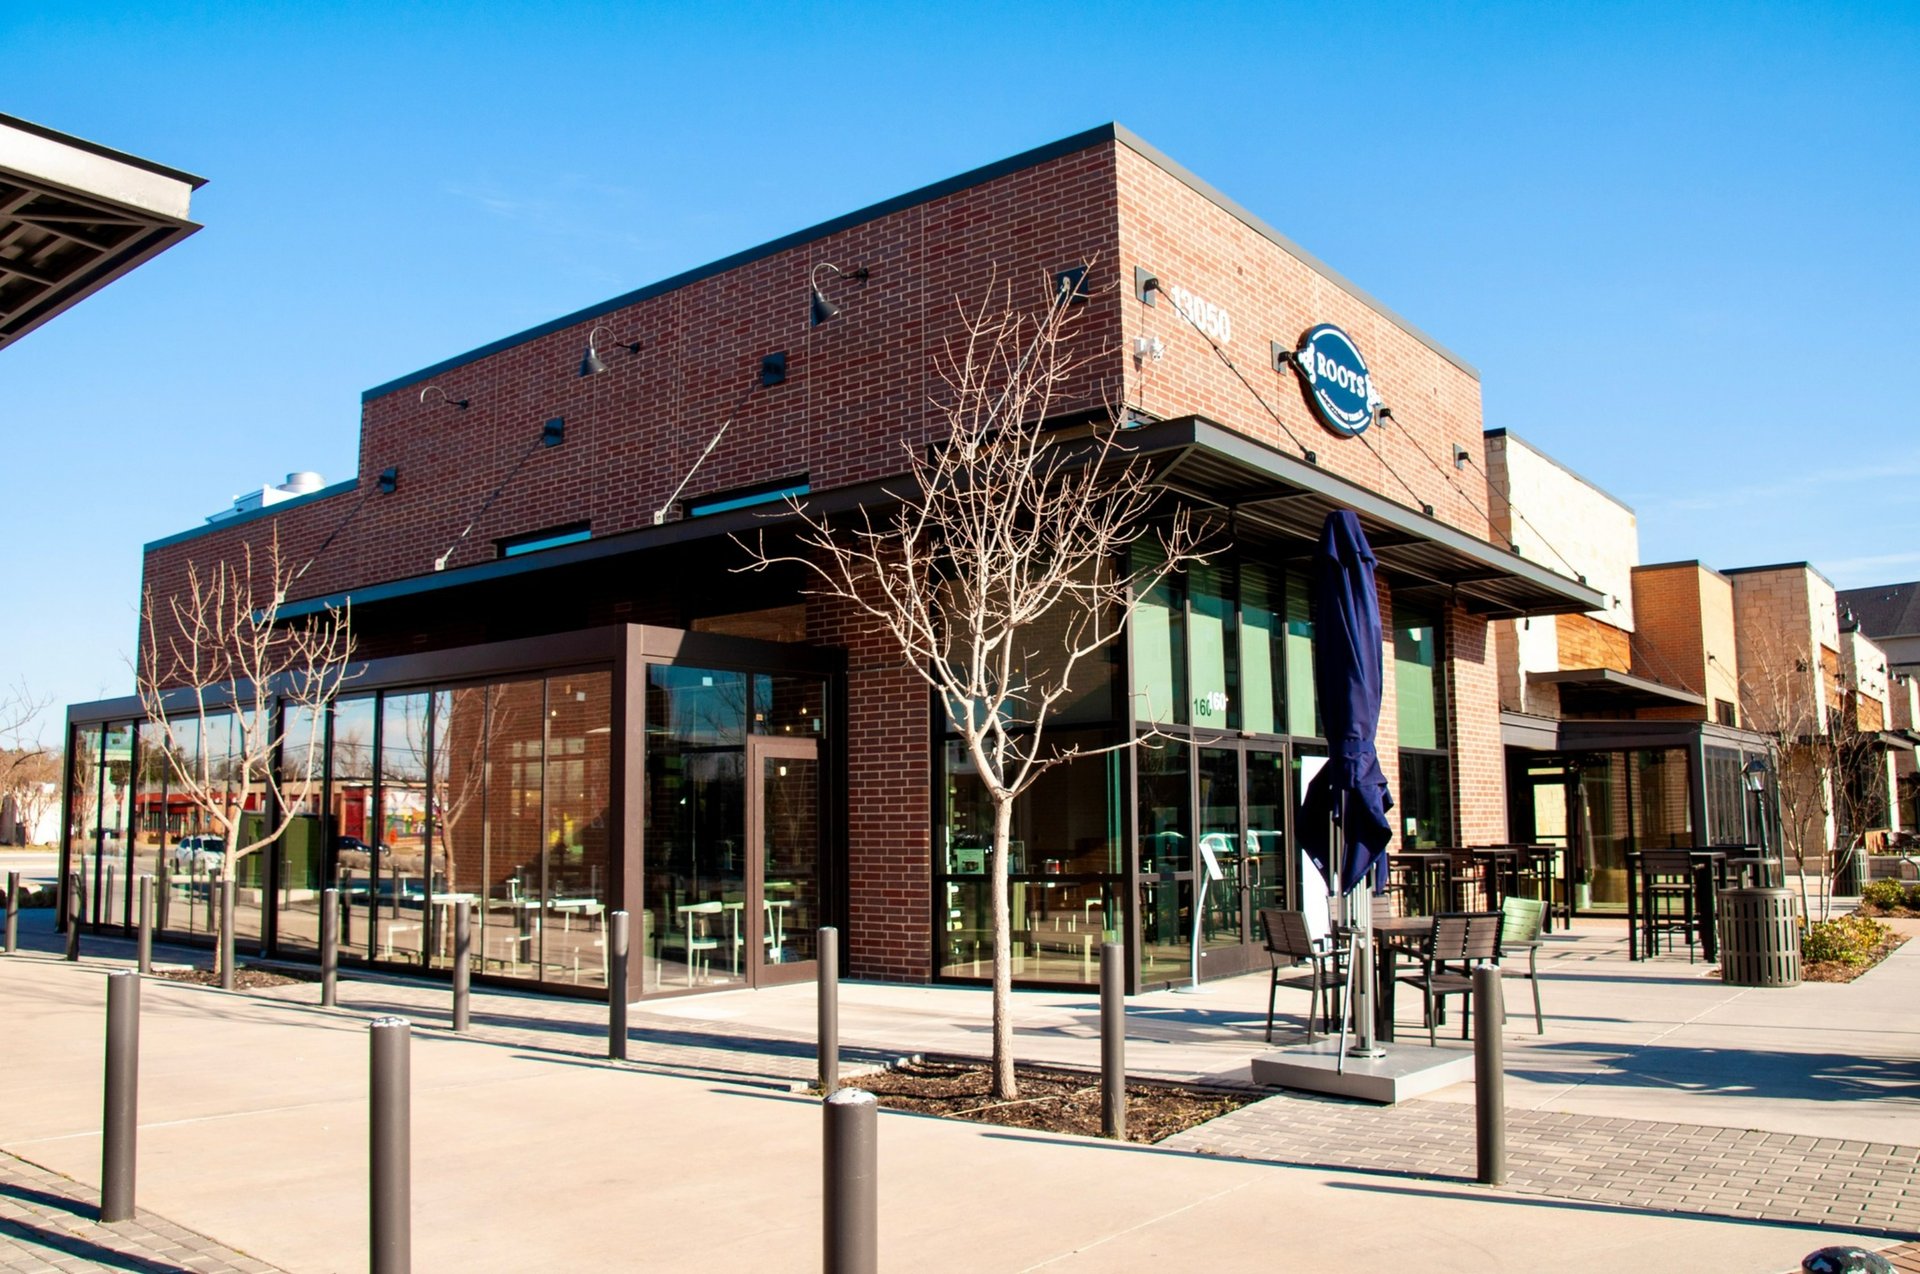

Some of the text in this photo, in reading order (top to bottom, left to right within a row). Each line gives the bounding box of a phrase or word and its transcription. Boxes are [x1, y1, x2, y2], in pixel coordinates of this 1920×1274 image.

[1171, 285, 1230, 343] 13050
[1317, 352, 1366, 398] ROOTS
[1207, 691, 1226, 711] 160
